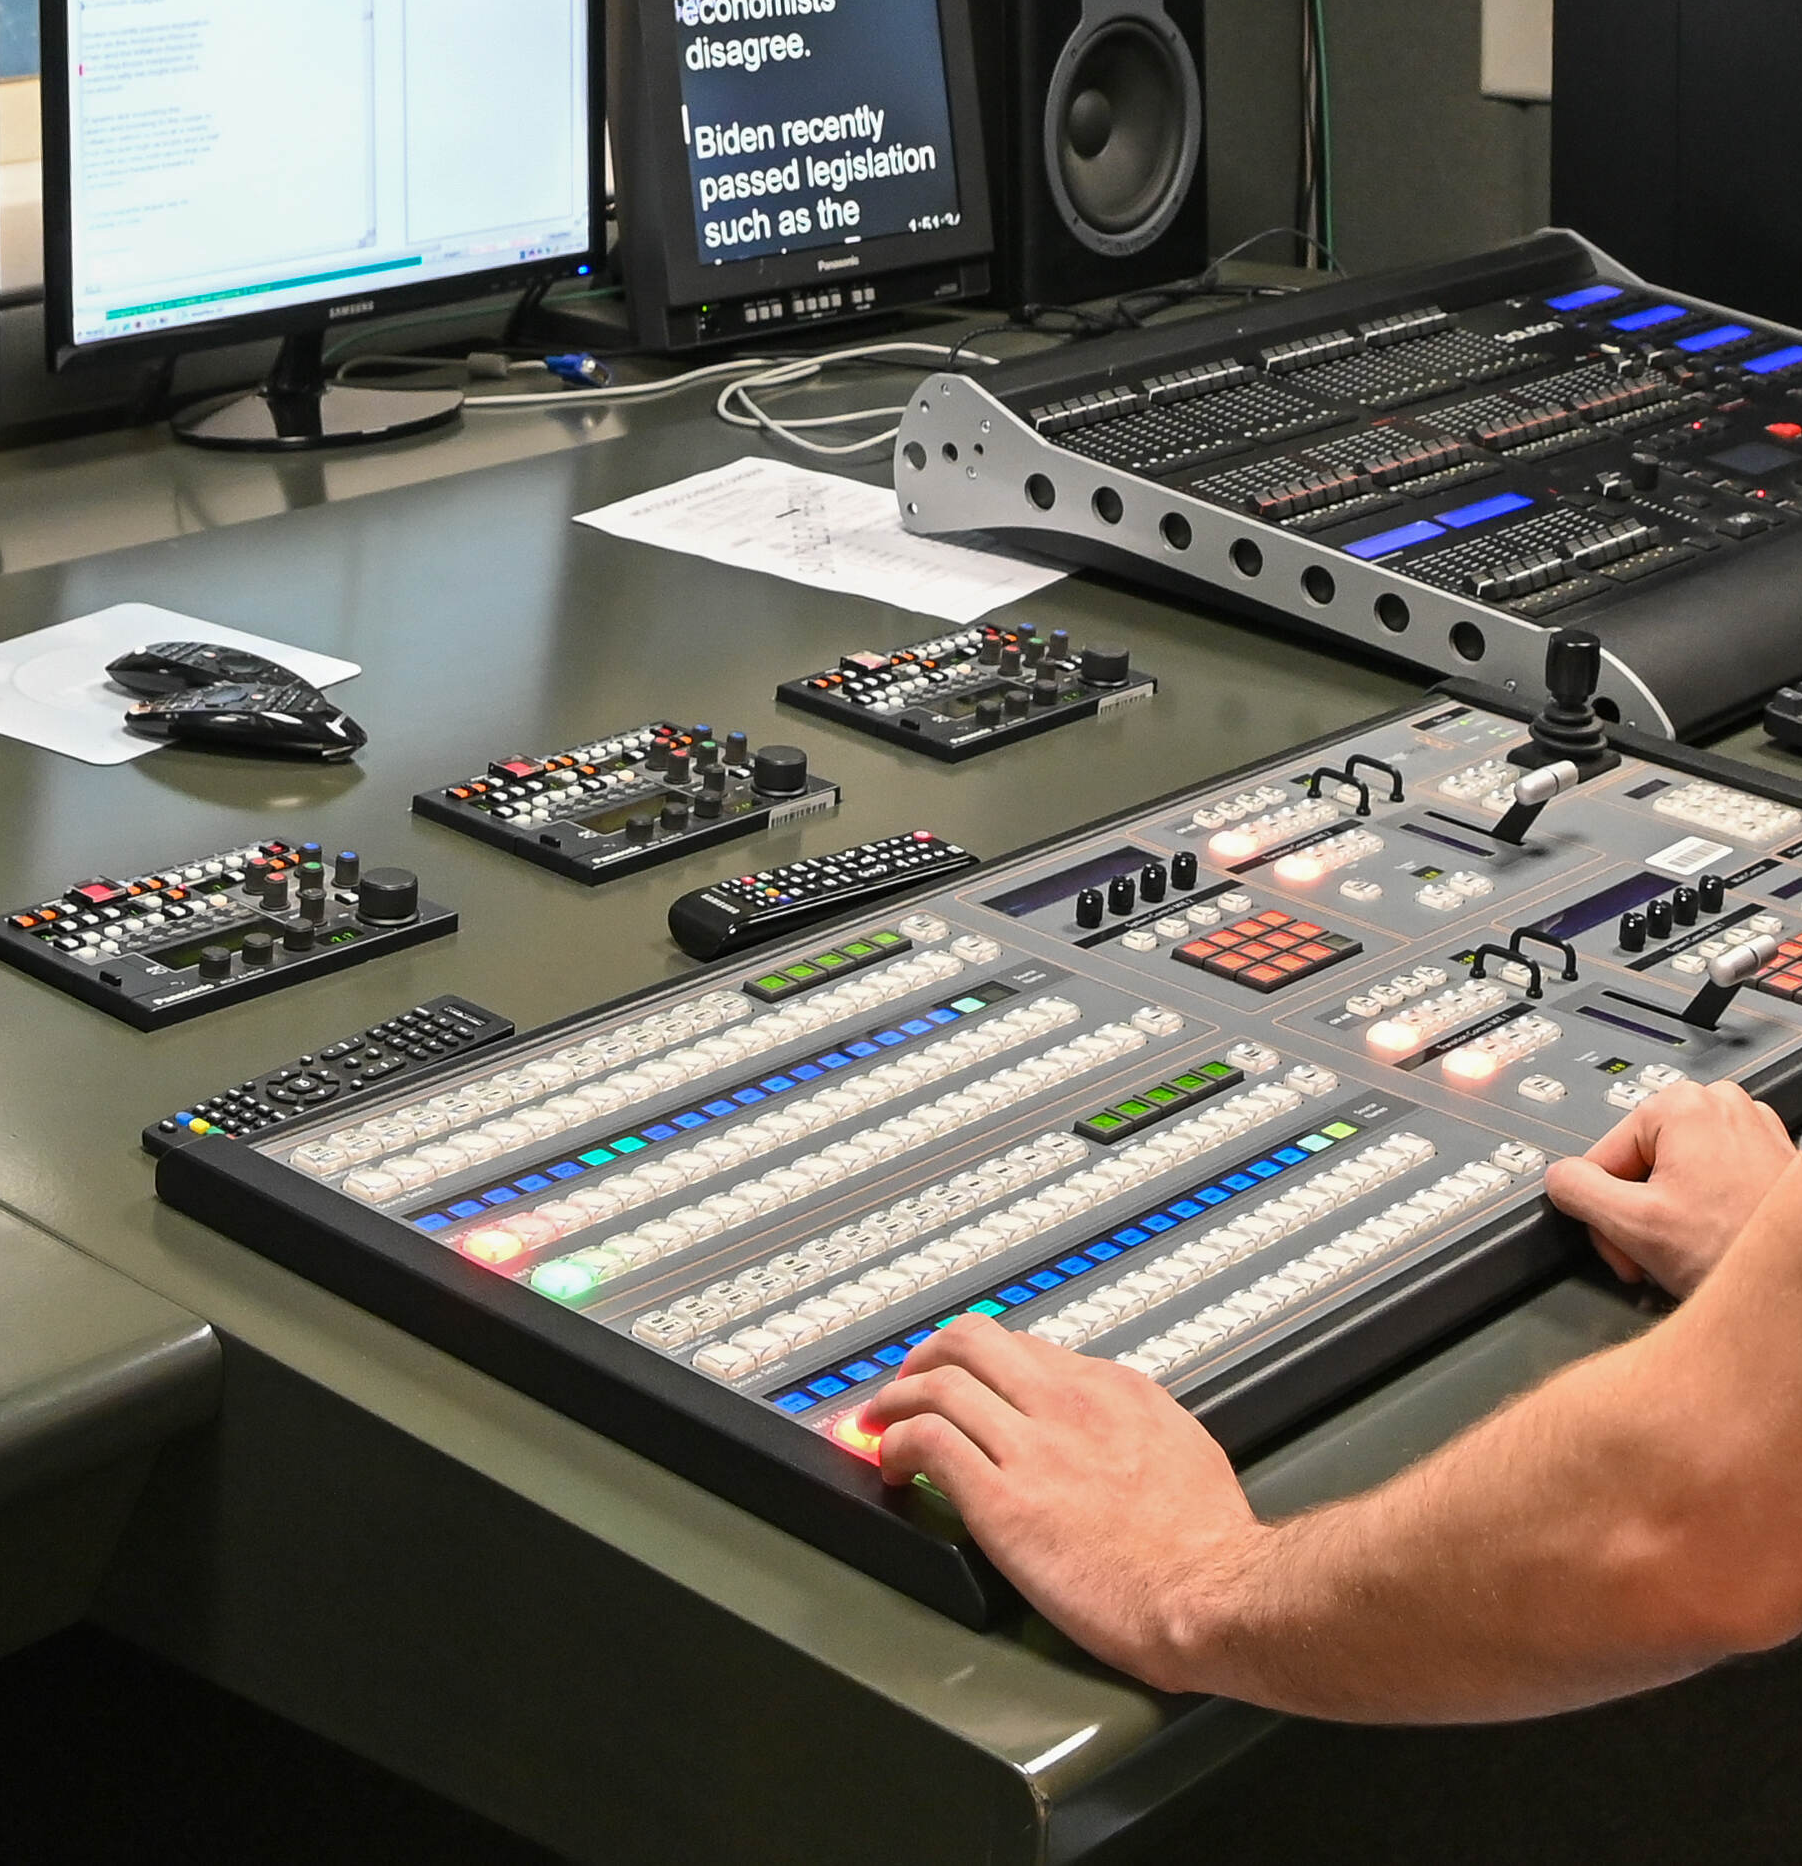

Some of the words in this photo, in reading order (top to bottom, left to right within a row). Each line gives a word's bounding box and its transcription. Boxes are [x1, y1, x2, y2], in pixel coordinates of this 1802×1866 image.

[685, 33, 811, 72] disagree.
[695, 121, 775, 159] Biden
[782, 104, 885, 144] recently
[700, 158, 800, 212] passed
[806, 143, 936, 192] legislation
[704, 208, 772, 248] such
[778, 207, 812, 237] as
[817, 197, 861, 230] the
[329, 300, 374, 319] SAMSUNG
